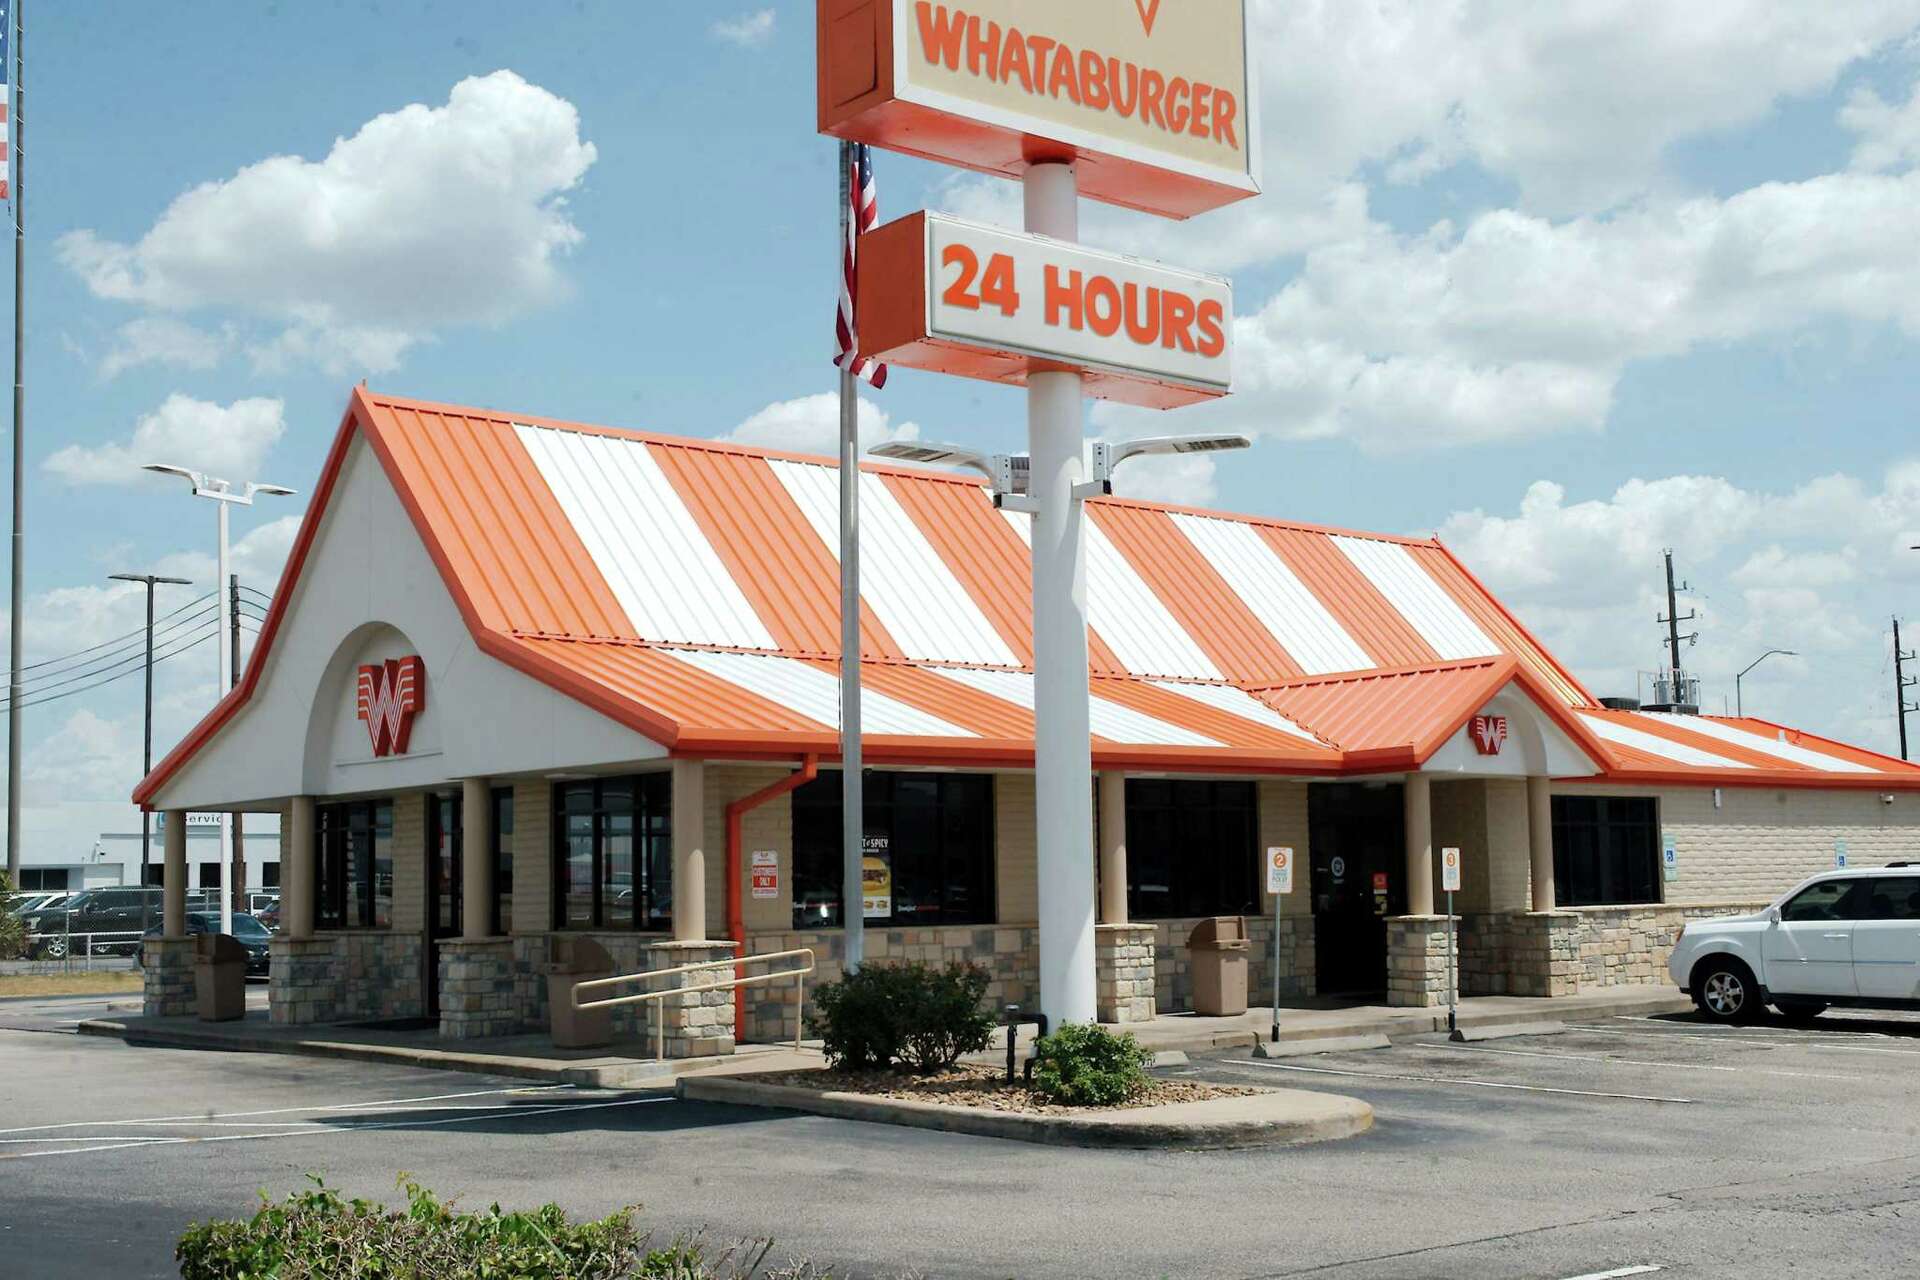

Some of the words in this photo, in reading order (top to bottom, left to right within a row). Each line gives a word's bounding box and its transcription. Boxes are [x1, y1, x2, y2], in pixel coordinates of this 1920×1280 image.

[915, 1, 1239, 151] WHATABURGER
[942, 244, 1020, 317] 24
[1044, 264, 1226, 358] HOURS
[1275, 854, 1285, 866] 2
